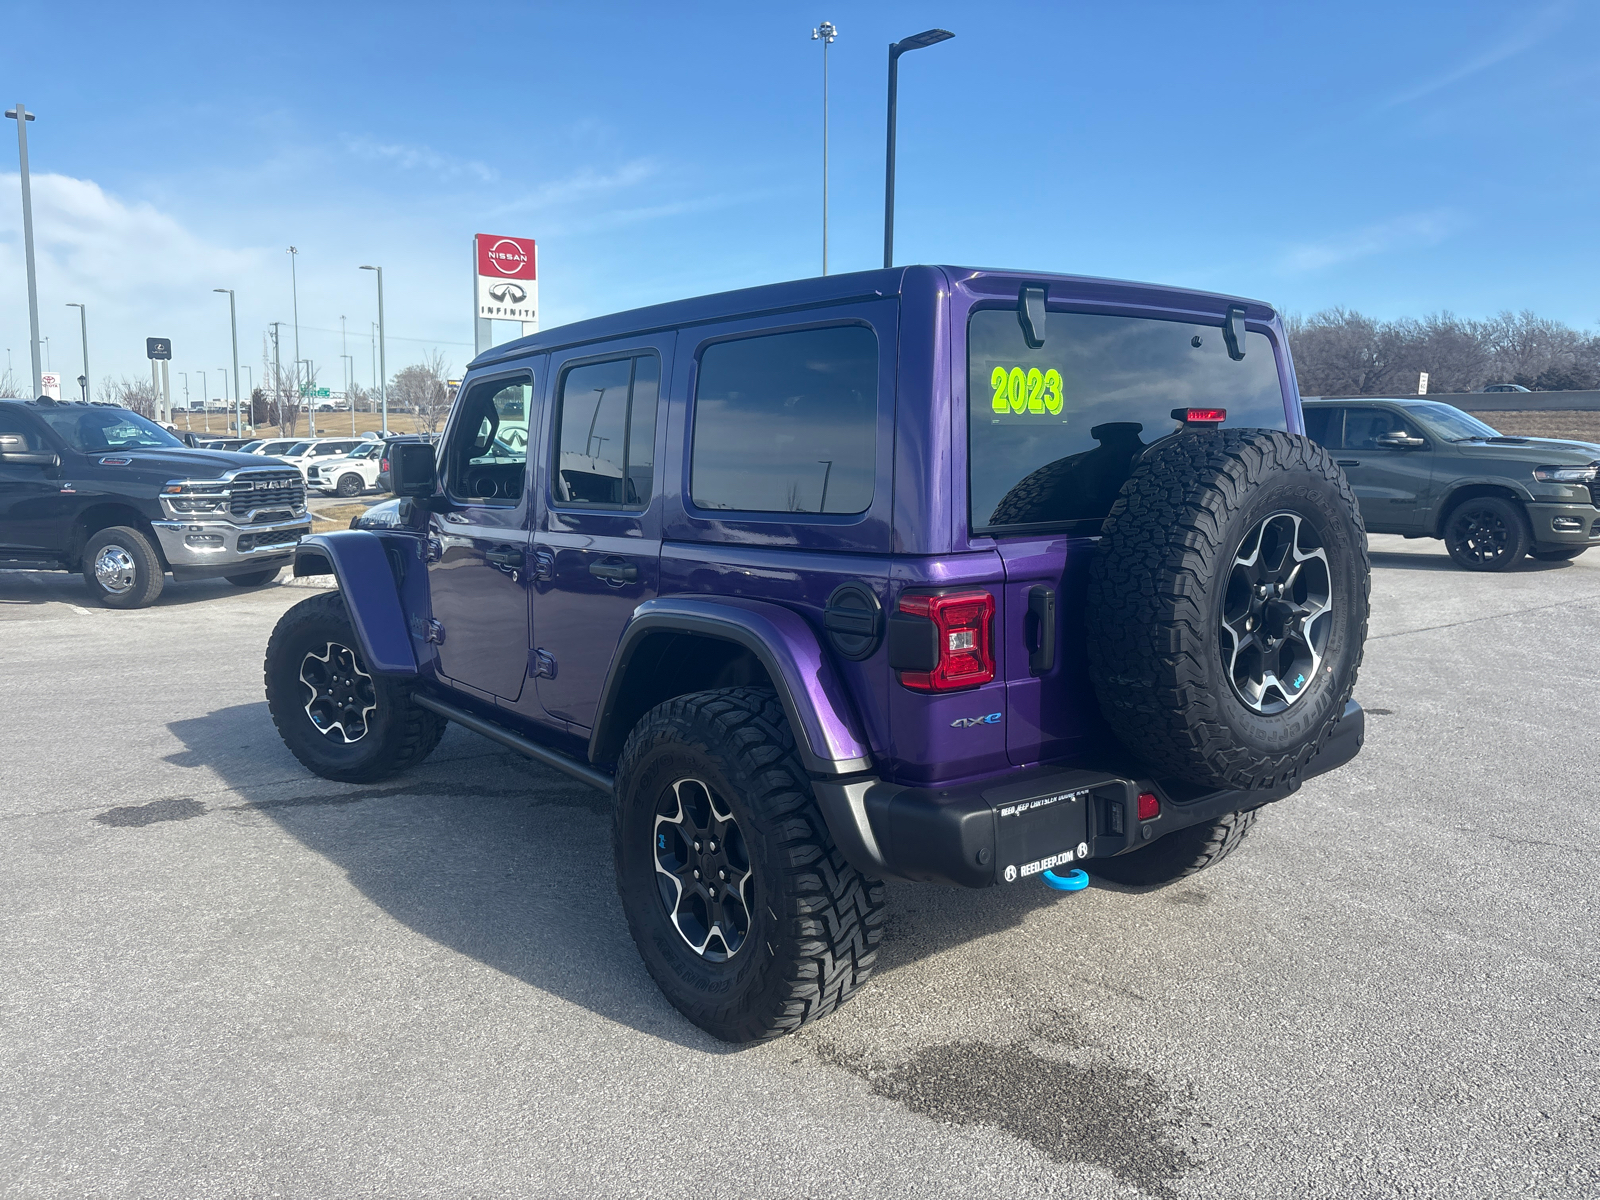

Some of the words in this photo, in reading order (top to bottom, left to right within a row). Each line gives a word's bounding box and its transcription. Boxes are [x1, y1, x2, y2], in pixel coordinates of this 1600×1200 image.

[488, 251, 527, 262] NISSAN
[481, 305, 535, 318] INFINITI
[991, 366, 1063, 415] 2023
[254, 478, 293, 490] RAM
[633, 752, 674, 809] TOYO
[1000, 805, 1016, 818] REED
[1015, 802, 1030, 813] JEEP
[1020, 850, 1074, 877] REEDJEEP.COM
[653, 936, 731, 994] COUNTRY
